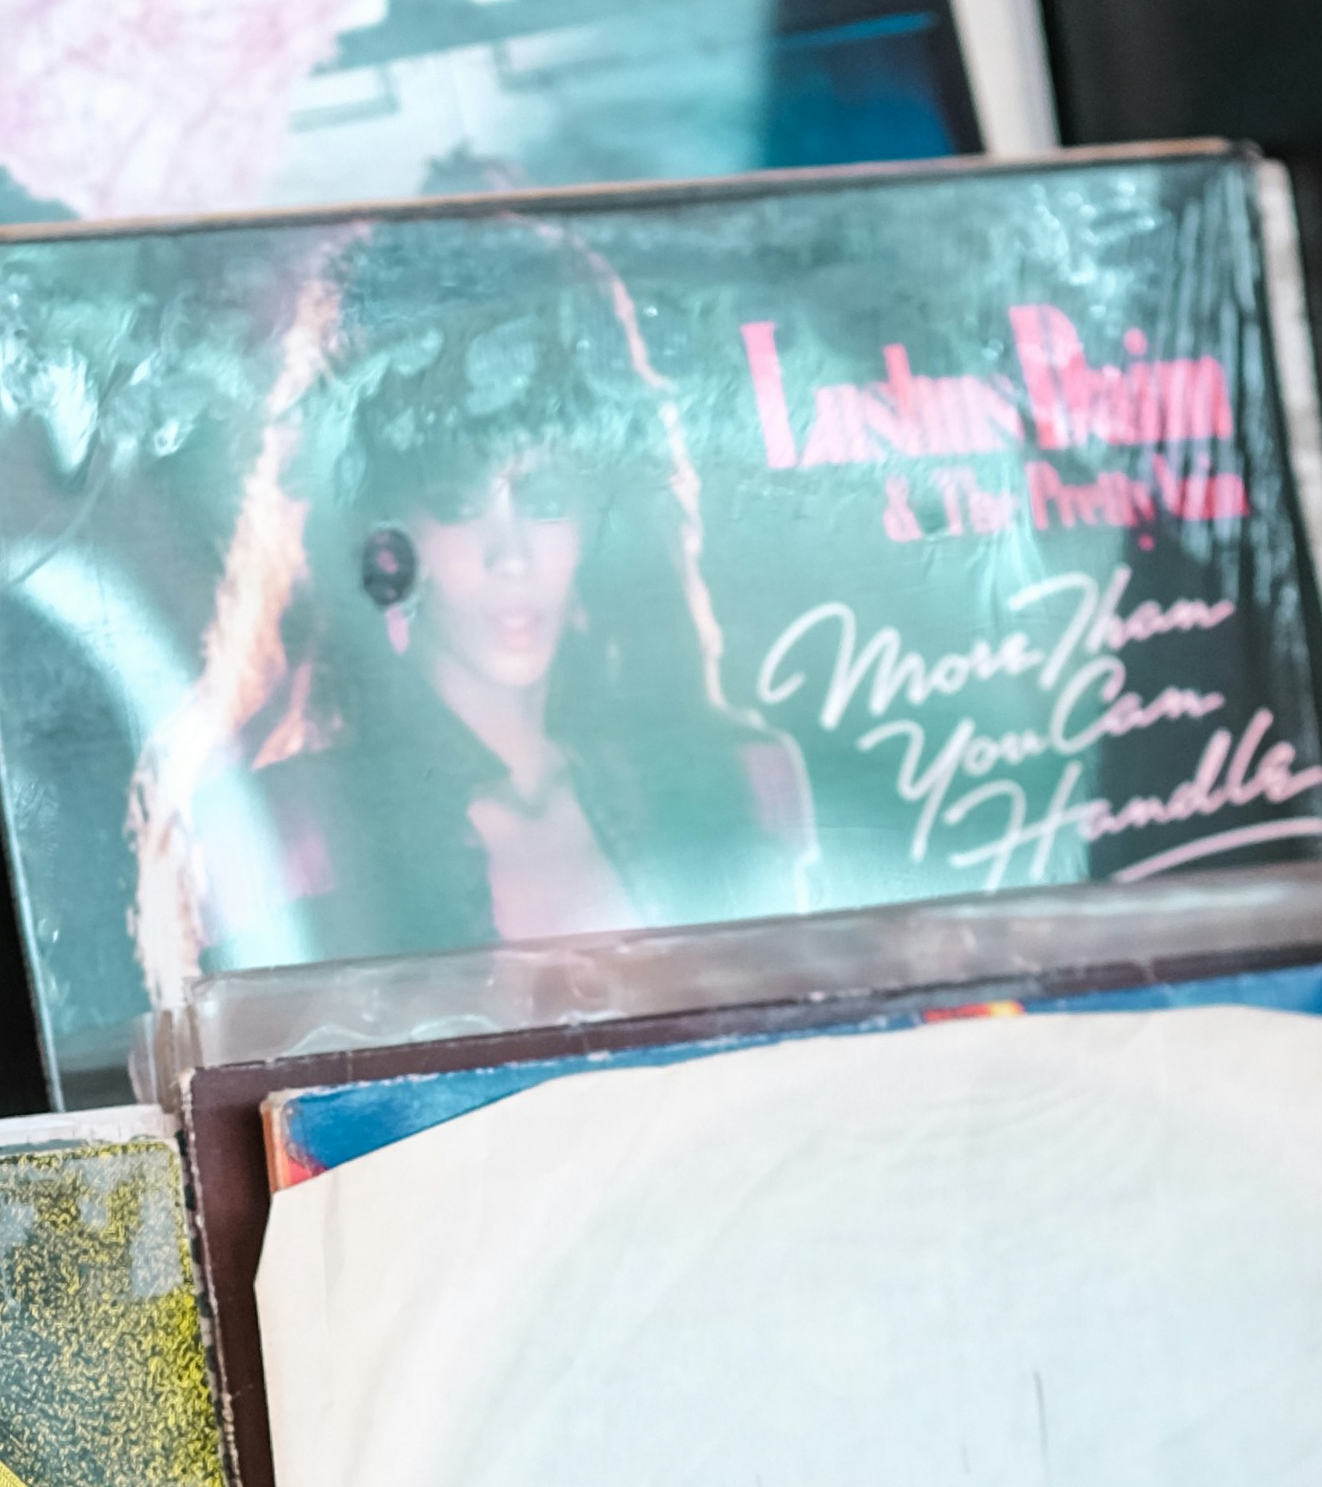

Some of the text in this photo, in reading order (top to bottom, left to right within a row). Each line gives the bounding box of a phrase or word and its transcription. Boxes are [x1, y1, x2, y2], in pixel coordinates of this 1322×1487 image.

[757, 565, 1235, 730] More Than
[858, 656, 1224, 862] You Can
